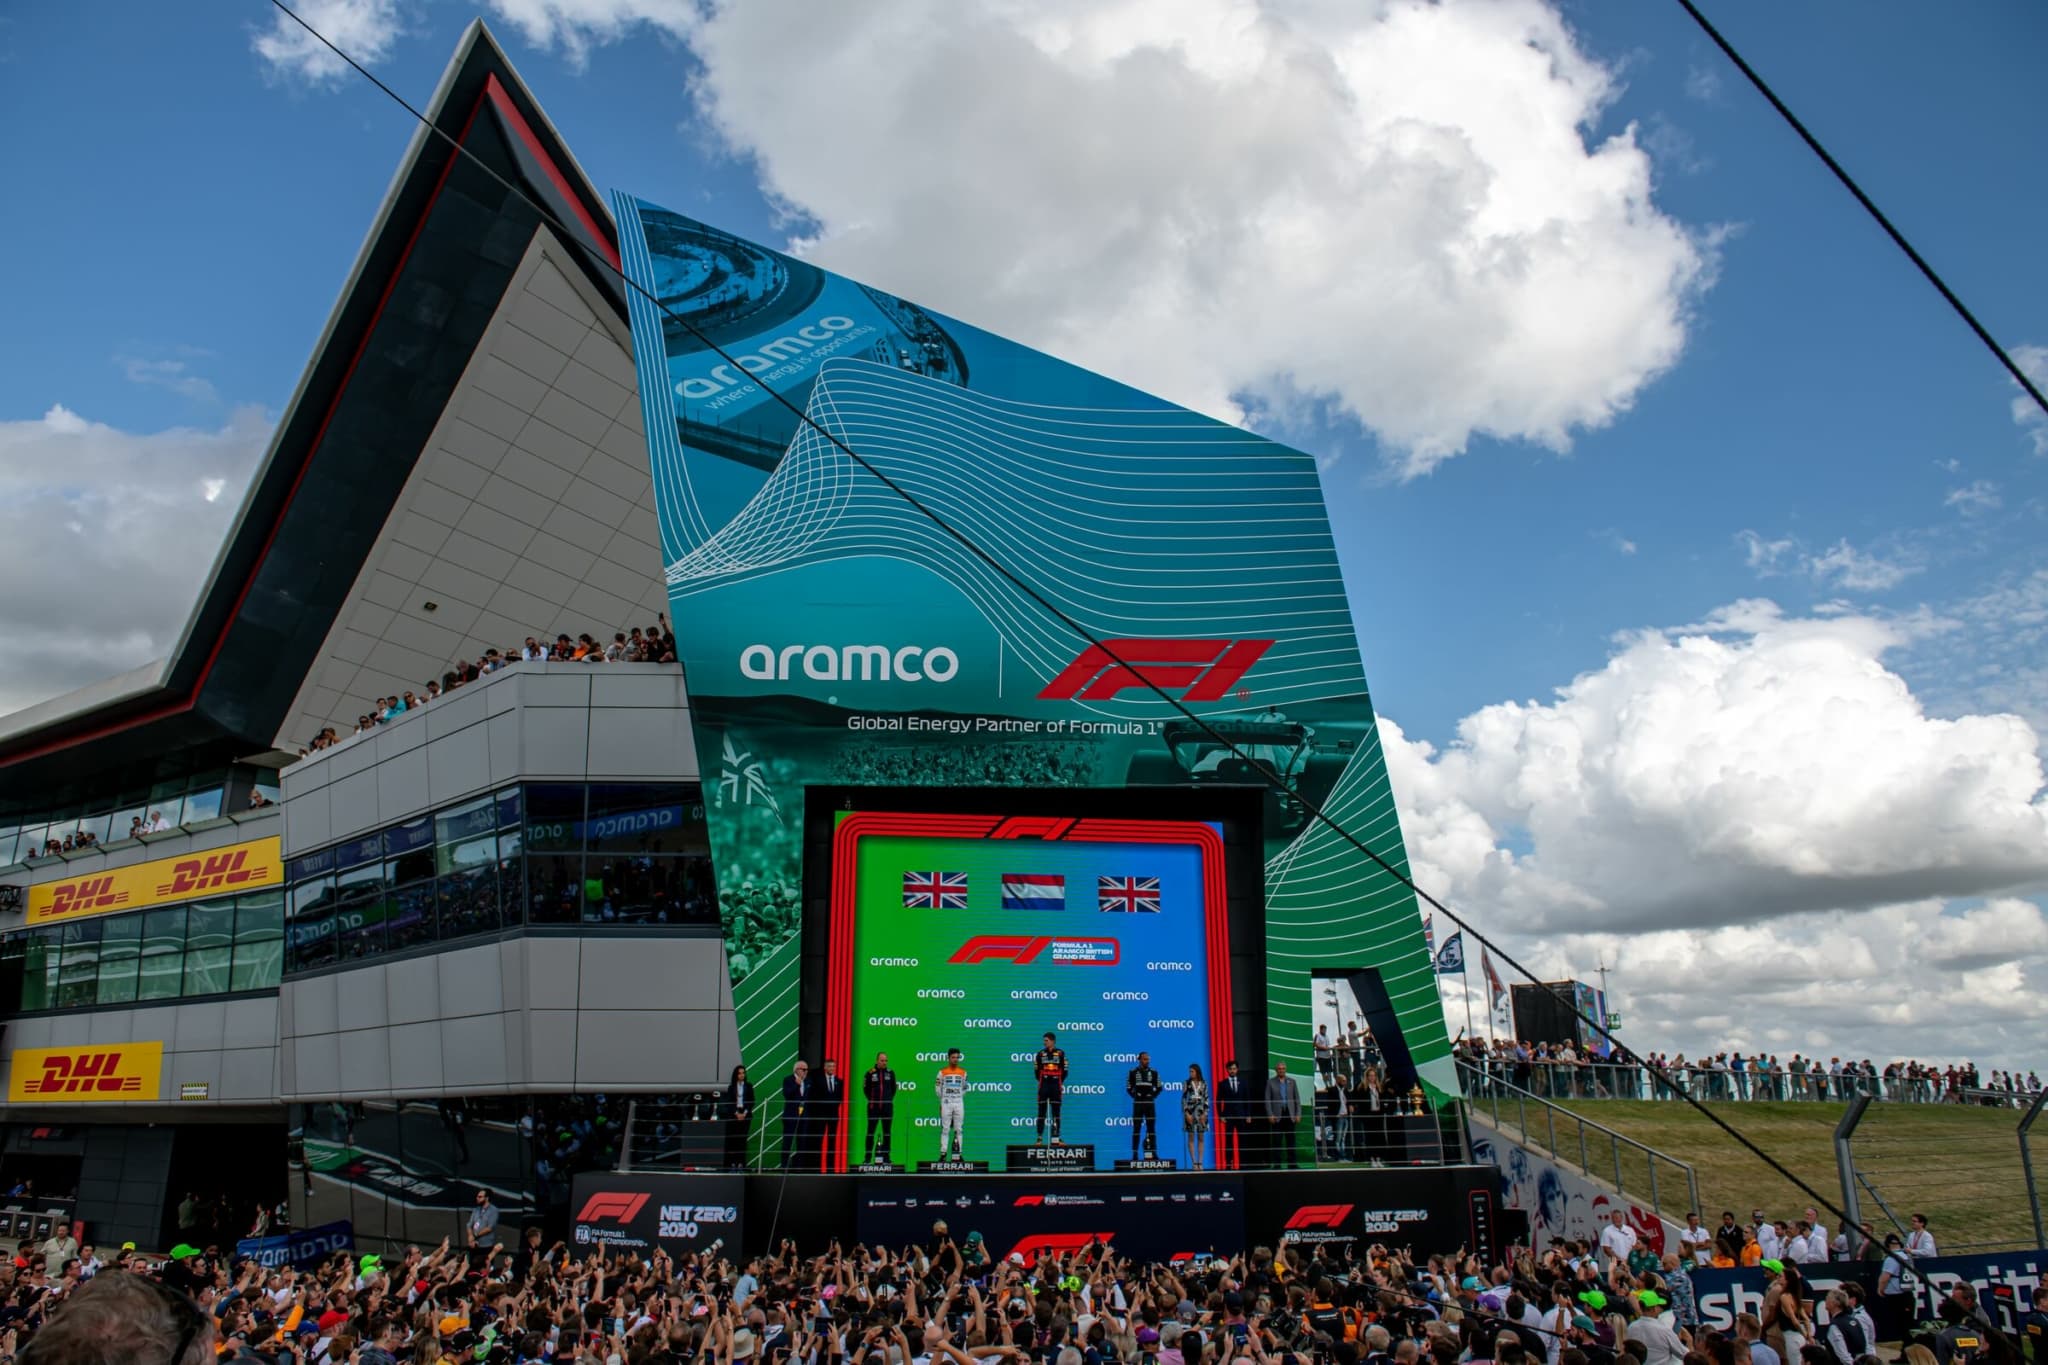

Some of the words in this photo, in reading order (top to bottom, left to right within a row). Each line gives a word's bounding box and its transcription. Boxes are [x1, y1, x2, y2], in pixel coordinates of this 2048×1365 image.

[675, 316, 854, 398] aramco
[740, 644, 959, 682] aramco
[847, 716, 902, 731] Global
[907, 716, 971, 733] Energy
[975, 717, 1041, 733] Partner
[1047, 719, 1066, 733] of
[1070, 720, 1143, 735] Formula
[170, 850, 251, 894] DHL
[51, 876, 116, 915] DHL
[870, 957, 919, 966] aramco
[1146, 961, 1192, 971] aramco
[917, 989, 965, 999] aramco
[1010, 990, 1058, 1000] aramco
[1102, 991, 1149, 1001] aramco
[868, 1017, 918, 1027] aramco
[963, 1018, 1012, 1028] aramco
[1057, 1021, 1104, 1031] aramco
[1148, 1019, 1194, 1029] aramco
[1104, 1053, 1139, 1062] aram
[39, 1053, 124, 1093] DHL
[1027, 1148, 1087, 1159] FERRARI
[930, 1163, 974, 1171] FERRARI
[660, 1205, 694, 1221] NET
[693, 1206, 737, 1223] ZERO
[1364, 1211, 1393, 1222] NET
[1394, 1210, 1428, 1221] ZERO
[658, 1221, 698, 1238] 2030
[1365, 1221, 1400, 1233] 2030
